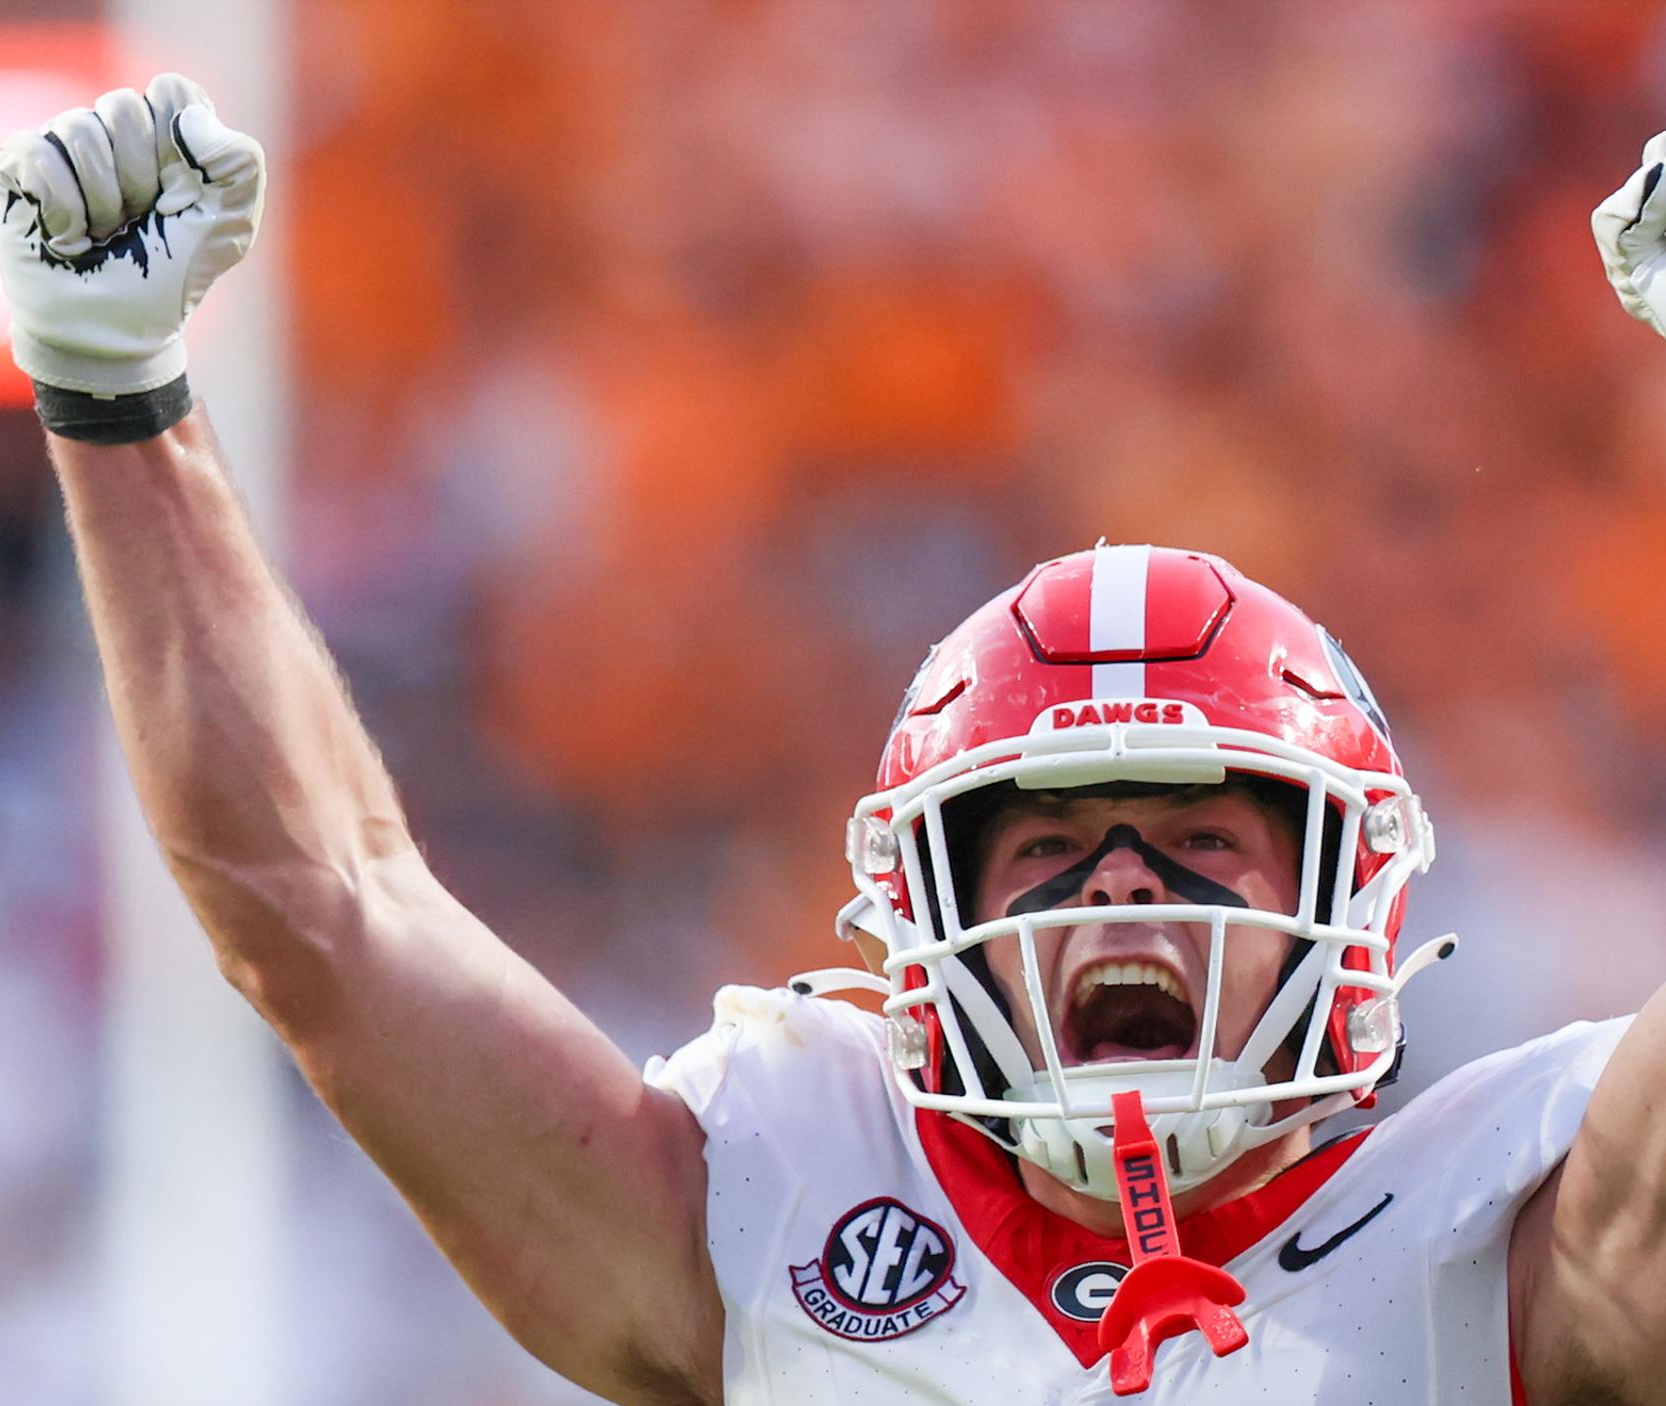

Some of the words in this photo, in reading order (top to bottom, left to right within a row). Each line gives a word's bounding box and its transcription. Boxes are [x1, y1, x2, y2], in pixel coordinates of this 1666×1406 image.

[1052, 702, 1184, 730] DAWGS
[1123, 1155, 1169, 1256] SHOC
[833, 1205, 945, 1305] SEC
[804, 1288, 934, 1336] GRADUATE
